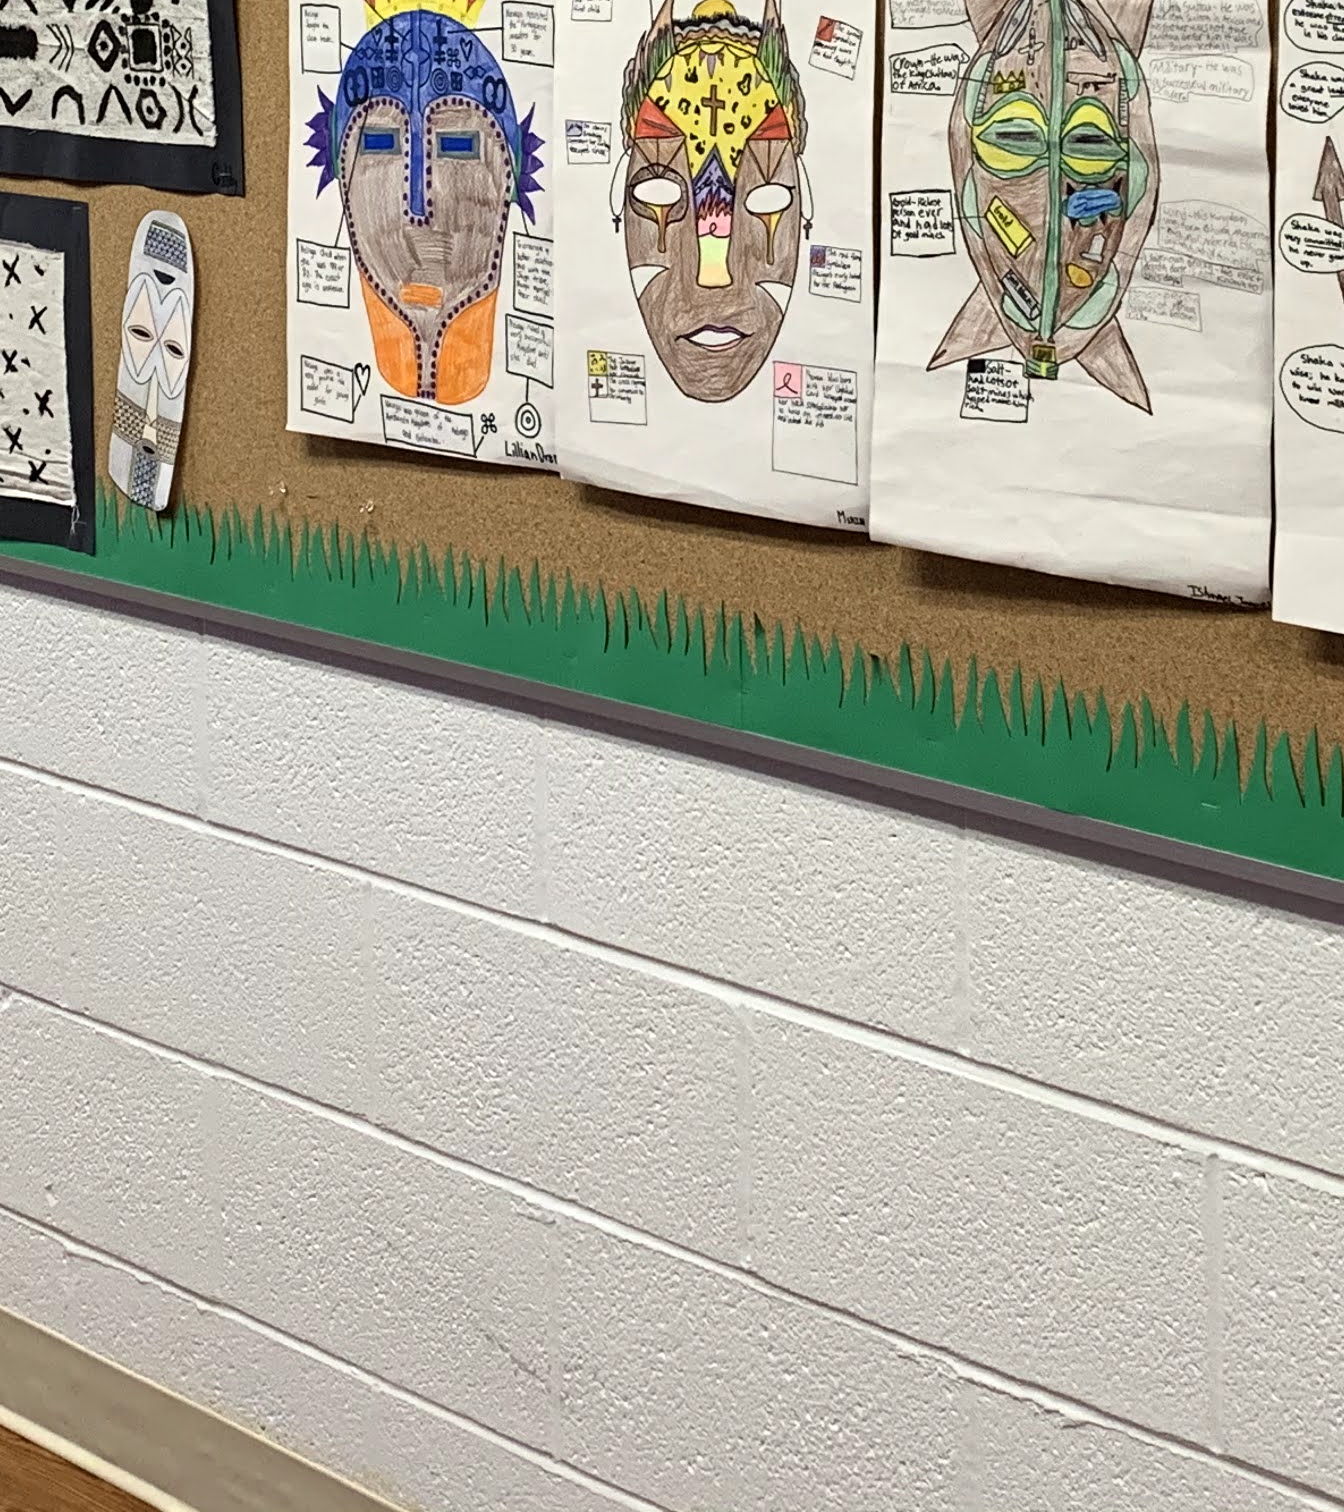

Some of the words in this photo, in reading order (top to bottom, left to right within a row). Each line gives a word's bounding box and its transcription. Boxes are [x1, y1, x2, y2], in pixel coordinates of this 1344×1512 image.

[1299, 69, 1328, 81] Shaka
[918, 208, 943, 218] ever
[916, 220, 937, 231] had
[1291, 219, 1320, 233] Shaka
[1284, 234, 1301, 245] very
[1303, 249, 1325, 257] never
[1300, 354, 1333, 367] Shaka
